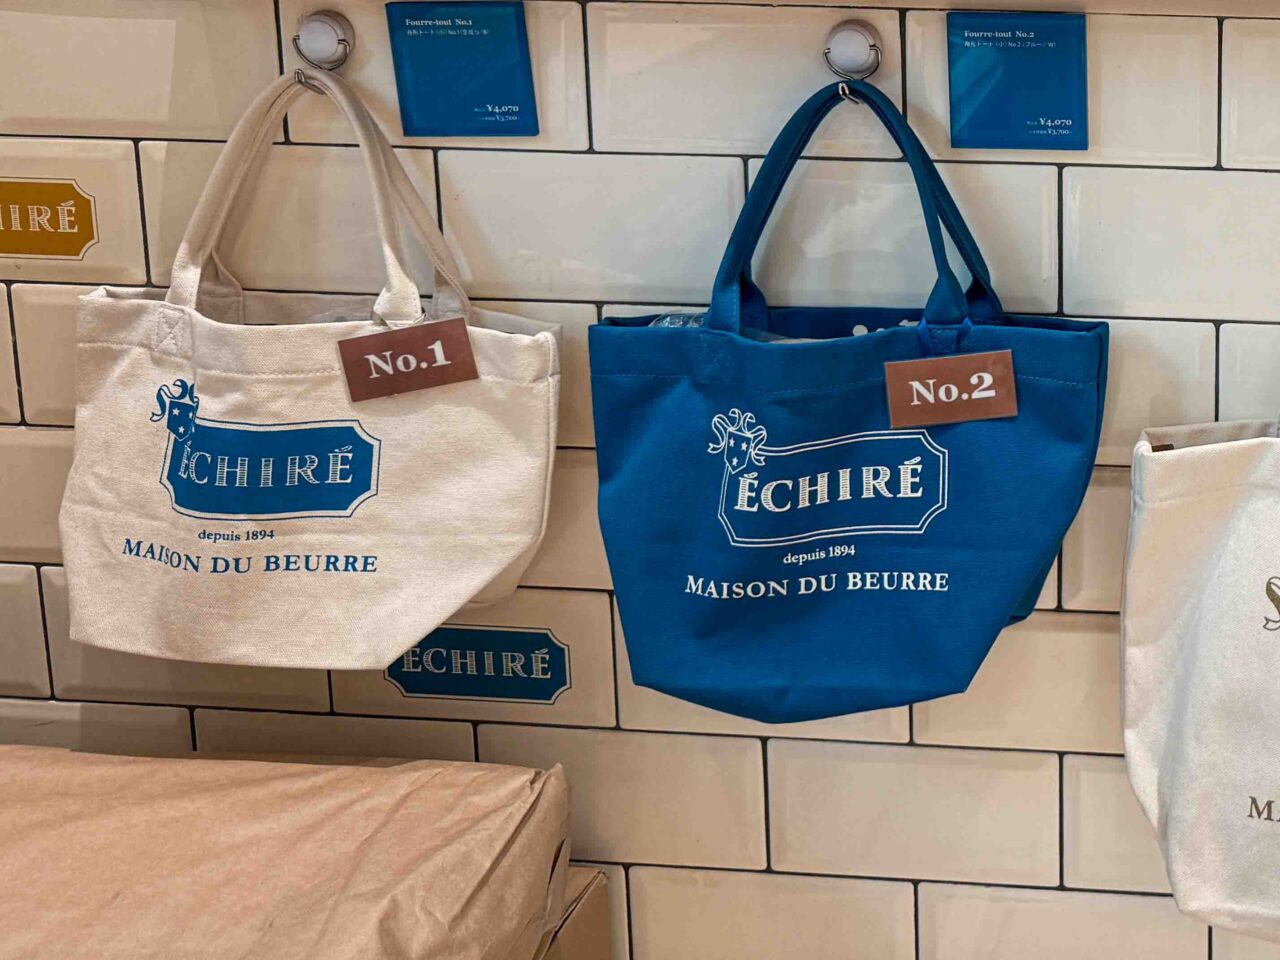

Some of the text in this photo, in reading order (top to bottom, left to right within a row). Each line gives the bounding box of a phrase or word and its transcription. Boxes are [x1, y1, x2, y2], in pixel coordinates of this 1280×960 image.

[405, 18, 473, 27] Fourre-tout No.1
[963, 29, 1035, 38] Fourre-tout No.2
[486, 104, 520, 115] ¥4,070
[1039, 117, 1073, 128] ¥4,070
[363, 339, 452, 379] No.1
[908, 371, 997, 407] No.2
[734, 456, 923, 512] ÉCHIRÉ
[198, 529, 275, 543] depuis 1894
[122, 537, 378, 574] MAISON DU BEURRE
[782, 544, 856, 565] depuis 1894
[684, 571, 950, 600] MAISON DU BEURRE
